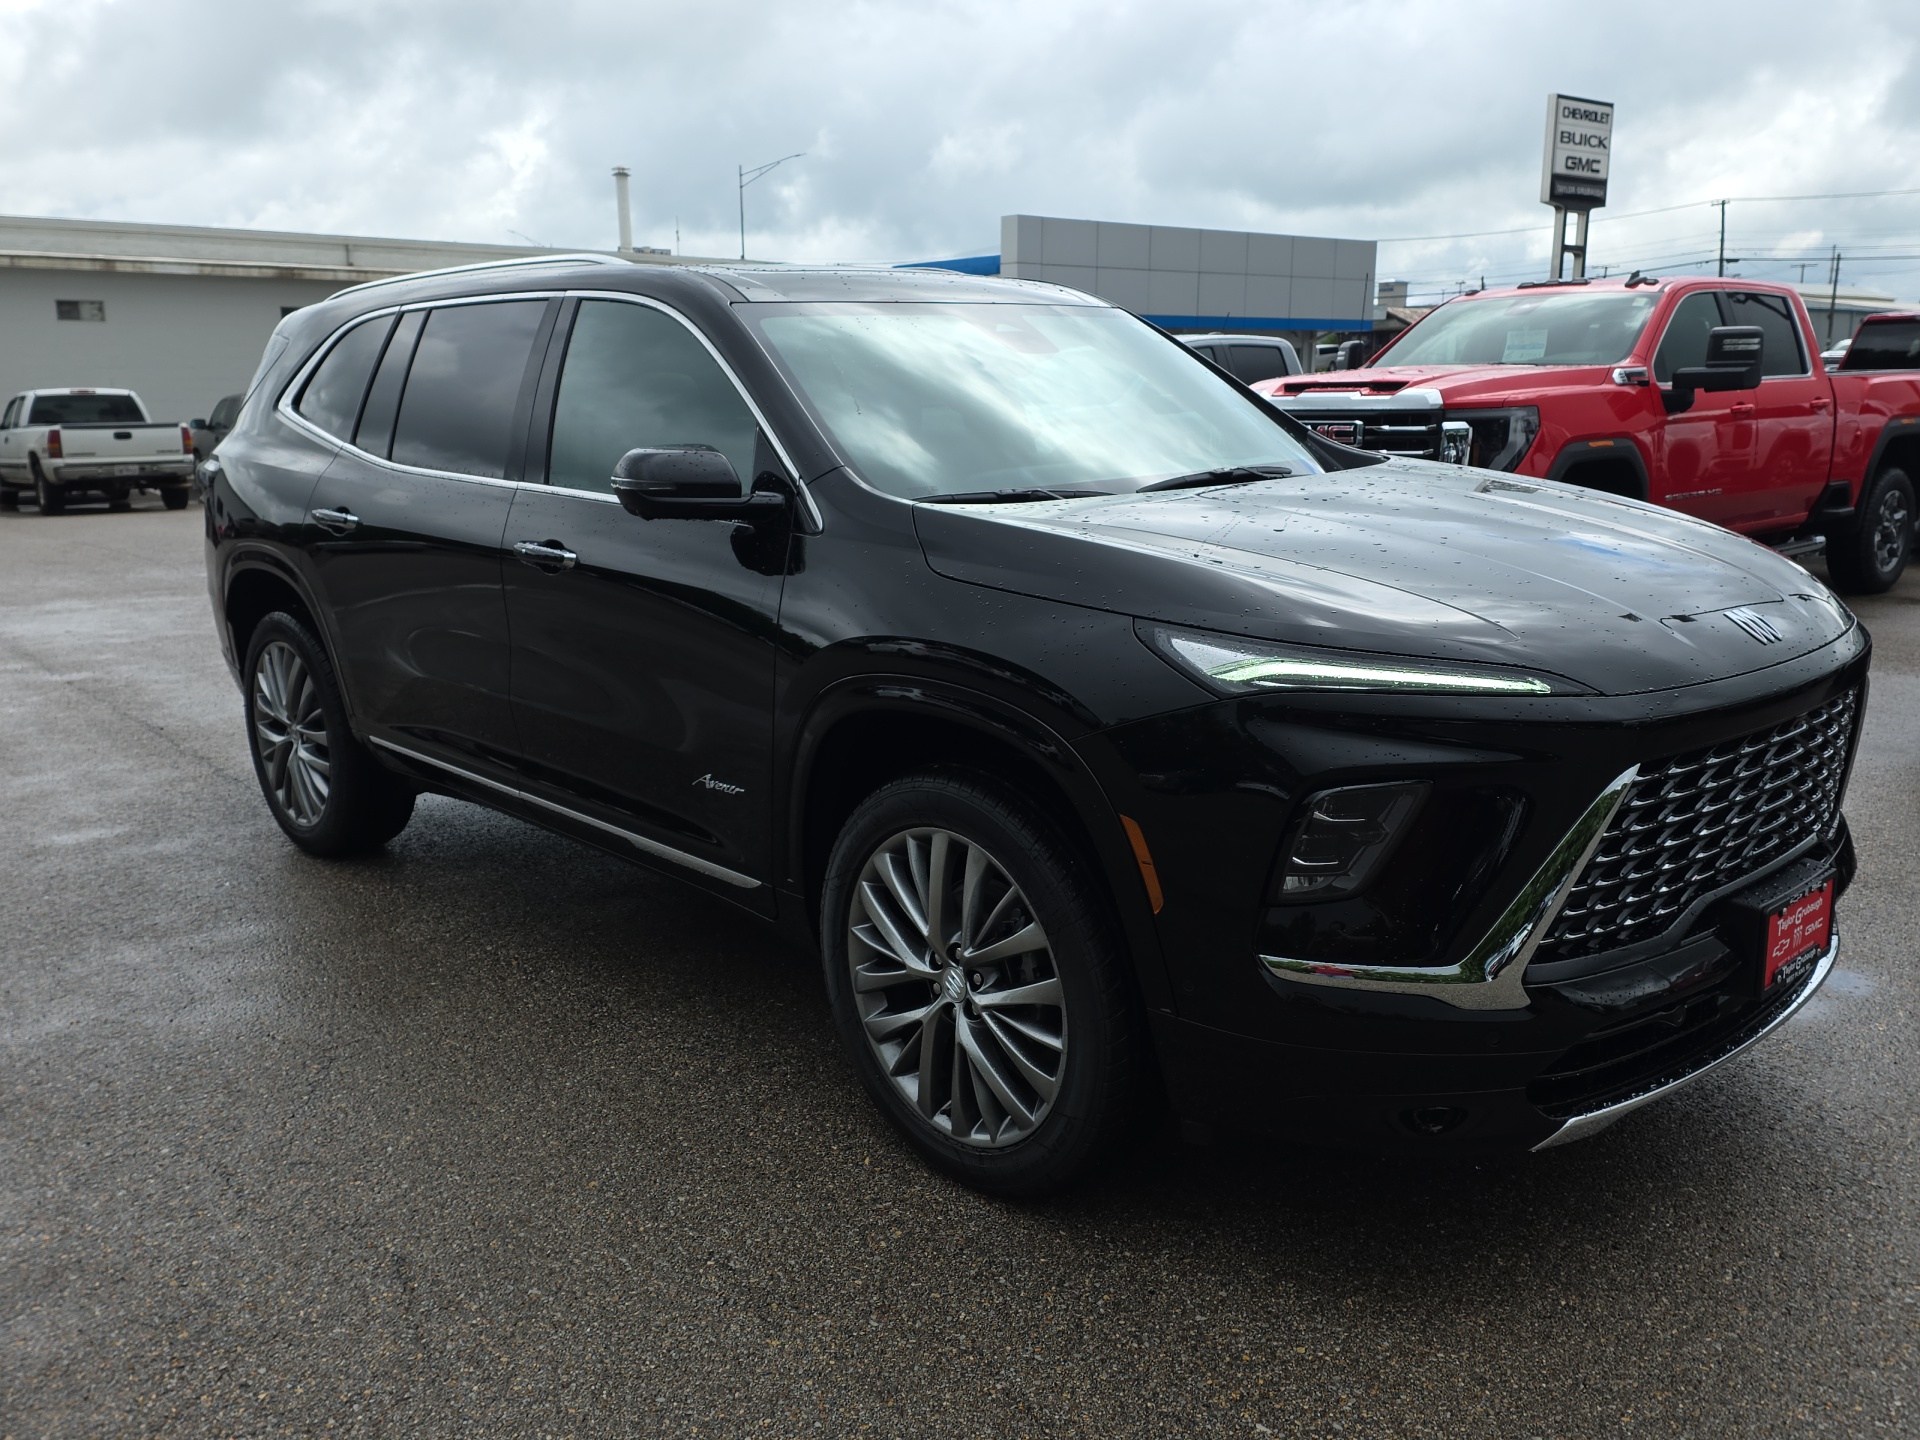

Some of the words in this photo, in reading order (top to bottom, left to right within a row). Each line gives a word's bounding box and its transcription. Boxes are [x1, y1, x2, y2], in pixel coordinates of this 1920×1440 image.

[1562, 106, 1610, 125] CHEVROLET
[1560, 130, 1608, 150] BUICK
[1565, 155, 1601, 174] GMC
[1777, 914, 1795, 937] Taylor
[1795, 896, 1823, 925] Grubaugh
[1805, 917, 1823, 936] GMC
